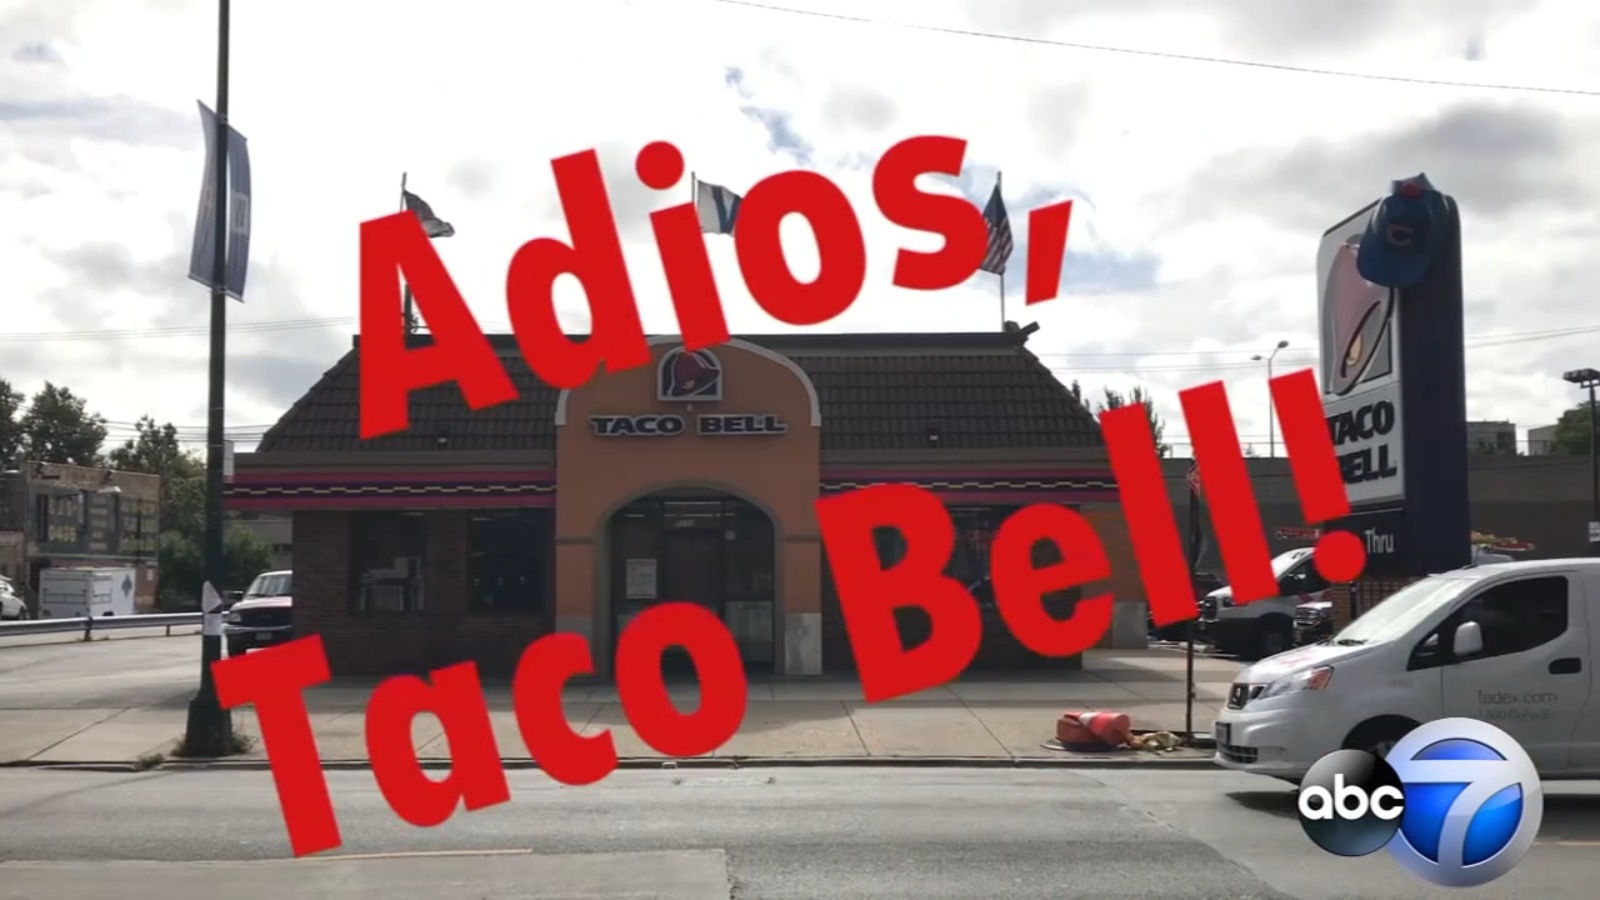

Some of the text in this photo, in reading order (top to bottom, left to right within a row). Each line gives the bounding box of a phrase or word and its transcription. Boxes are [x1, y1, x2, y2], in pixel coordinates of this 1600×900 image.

[589, 414, 788, 436] TACO BELL
[1365, 527, 1395, 555] Thru
[1477, 689, 1558, 705] fedex.com
